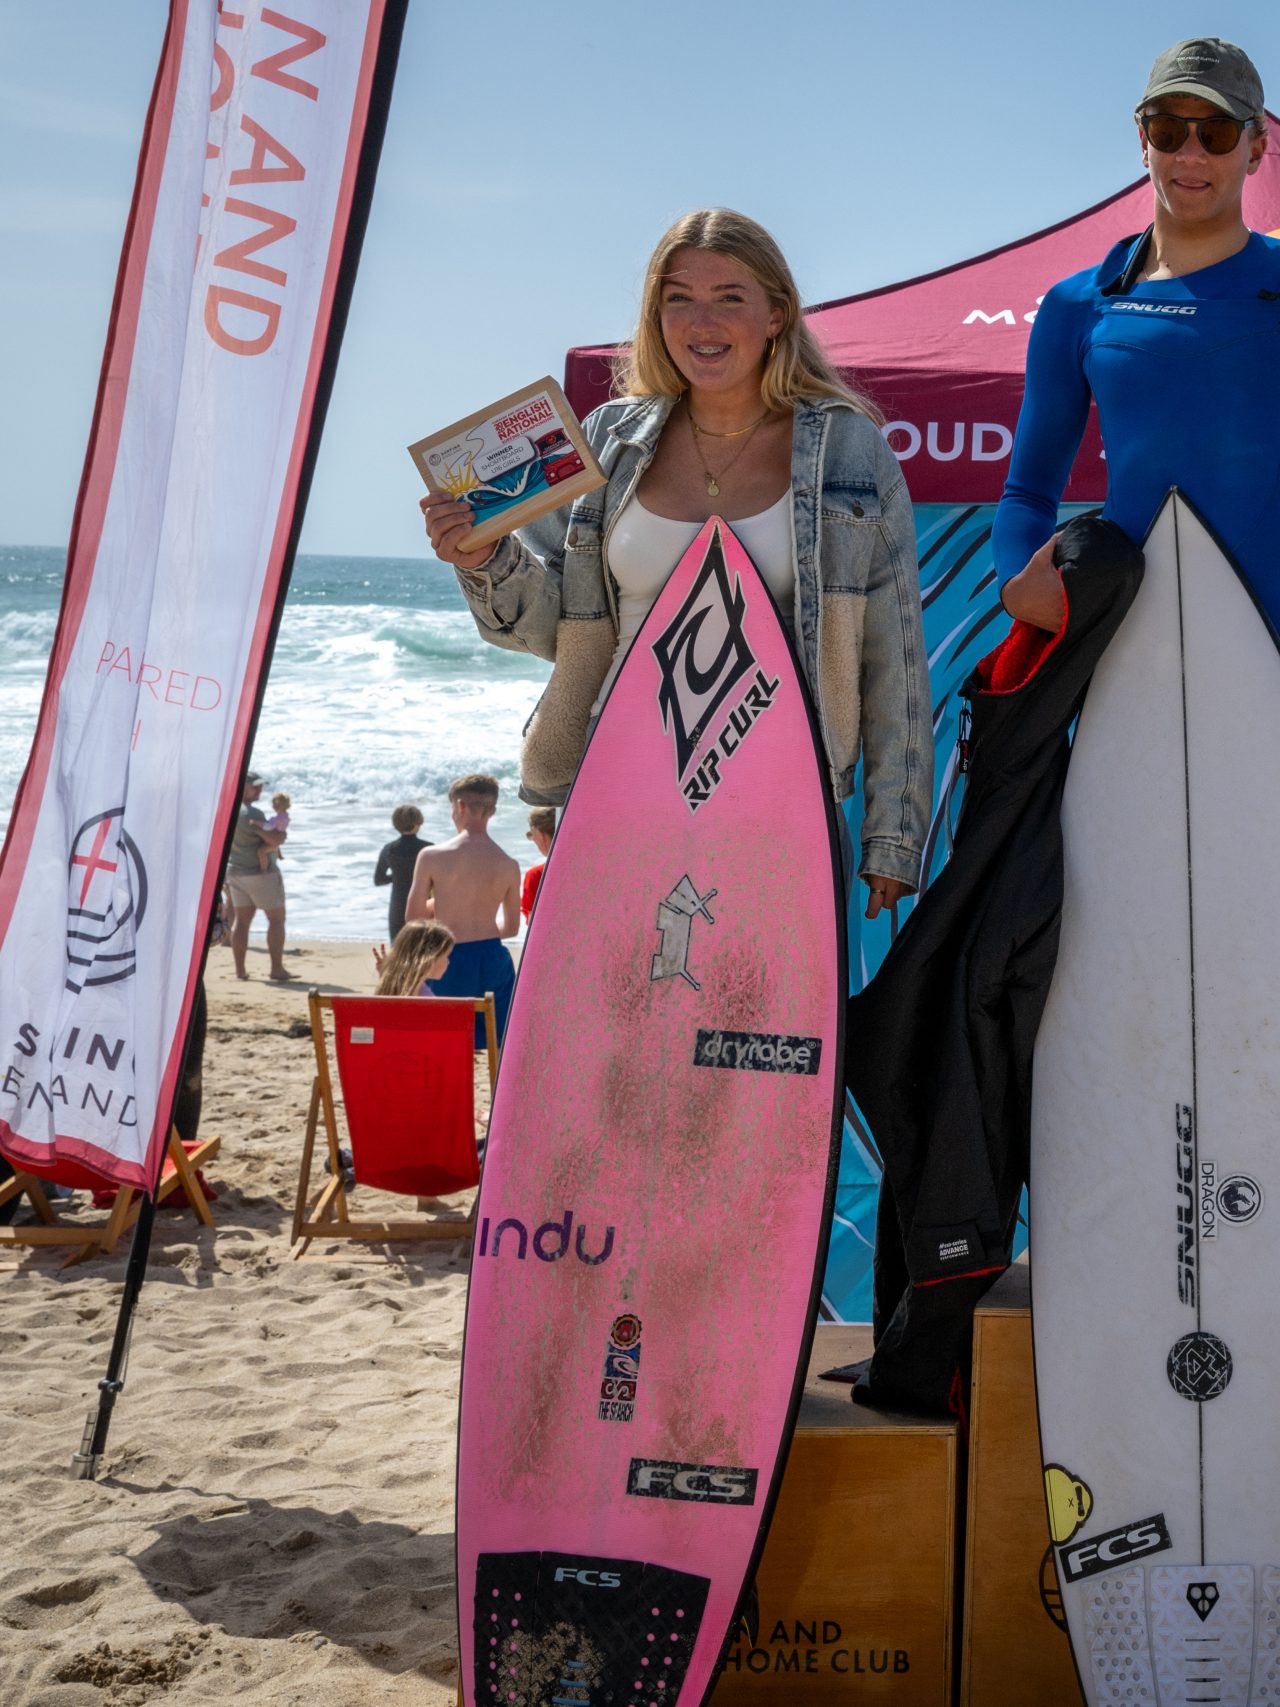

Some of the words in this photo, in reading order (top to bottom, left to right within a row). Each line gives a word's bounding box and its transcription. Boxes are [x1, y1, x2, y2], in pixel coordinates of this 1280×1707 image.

[1111, 301, 1197, 315] SNUGG
[498, 409, 553, 440] NATIONAL
[503, 399, 551, 428] ENGLISH
[486, 445, 513, 461] WINNER
[683, 749, 720, 812] RIP
[719, 669, 779, 750] CURL
[1175, 1103, 1195, 1308] SNUGG
[1201, 1162, 1215, 1239] DRAGON
[940, 1244, 969, 1256] ADVANCE
[636, 1466, 747, 1499] FCS
[1067, 1523, 1161, 1575] FCS
[554, 1567, 621, 1588] FCS
[769, 1620, 842, 1644] AND
[831, 1649, 911, 1674] CLUB
